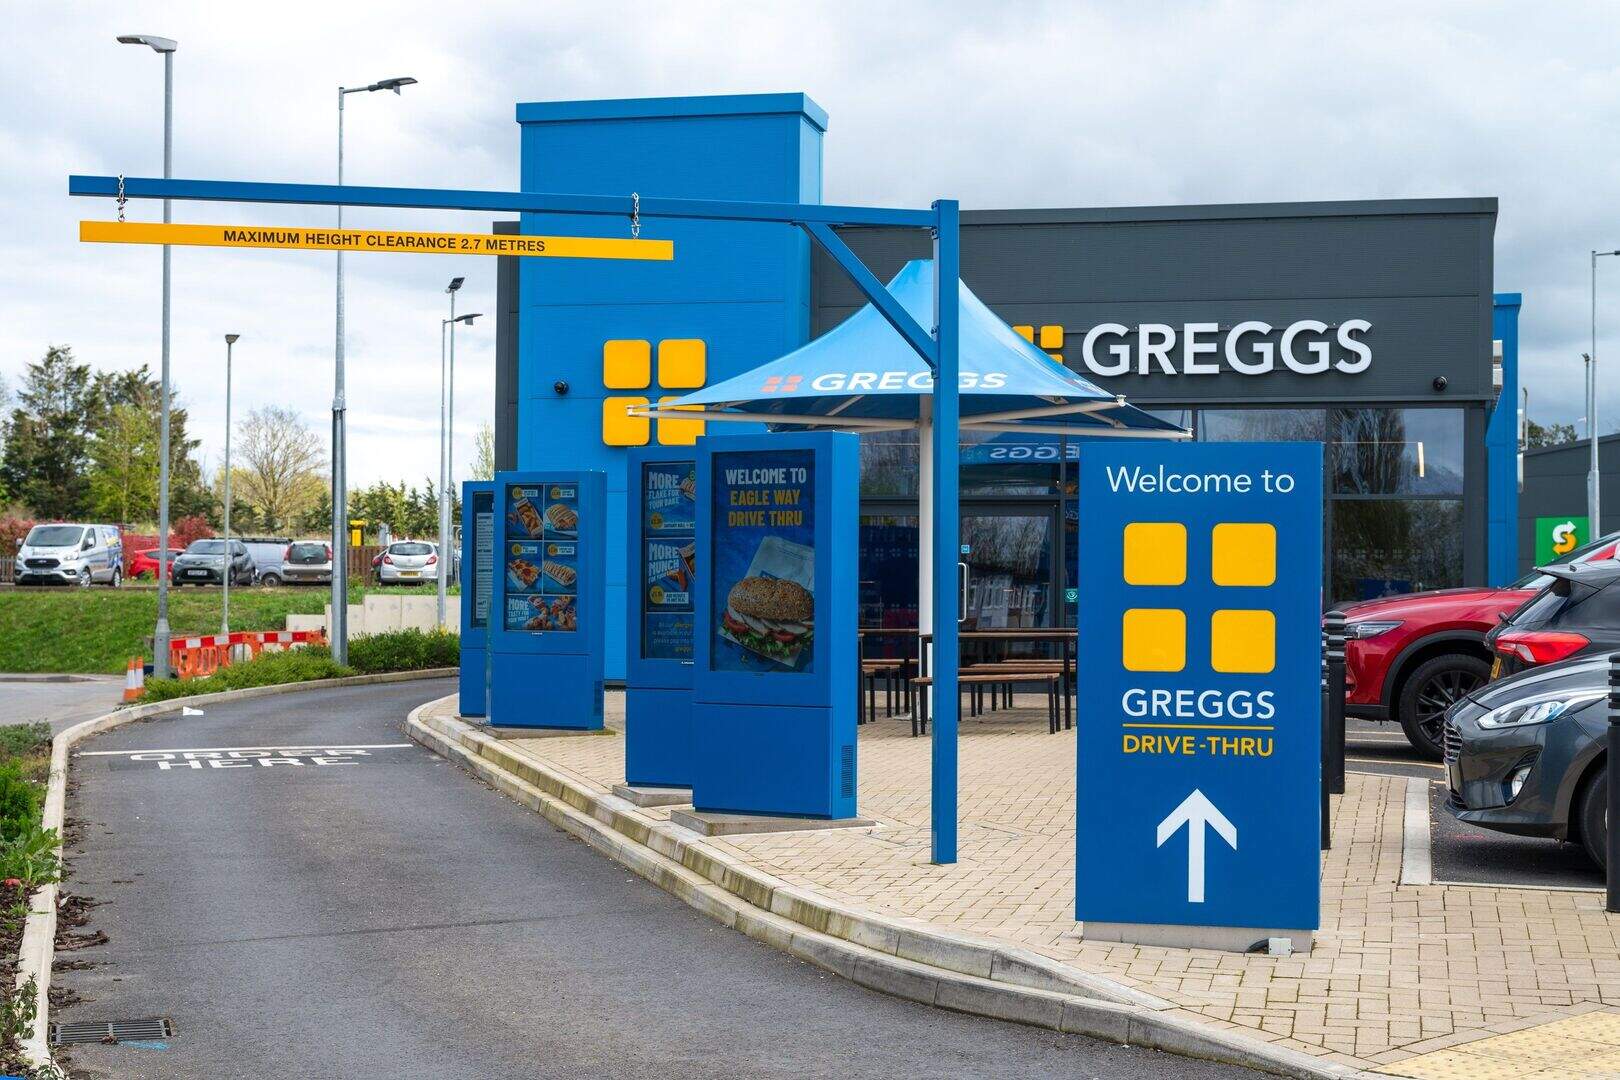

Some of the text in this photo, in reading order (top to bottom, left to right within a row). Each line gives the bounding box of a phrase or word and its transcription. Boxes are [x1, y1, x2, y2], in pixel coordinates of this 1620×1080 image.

[223, 230, 546, 252] MAXIMUM HEIGHT CLEARANCE 2.7 METRES
[1082, 319, 1372, 376] GREGGS
[811, 371, 1008, 391] GREGGS
[648, 471, 680, 490] MORE
[725, 467, 807, 485] WELCOME TO
[1106, 464, 1295, 493] Welcome to
[730, 489, 801, 506] EAGLE WAY
[728, 510, 803, 527] DRIVE THRU
[648, 542, 680, 561] MORE
[648, 557, 680, 577] MUNCH
[508, 597, 529, 611] MORE
[1121, 688, 1276, 719] GREGGS
[130, 749, 372, 761] ORDER
[1122, 734, 1274, 757] DRIVE-THRU
[158, 756, 360, 770] HERE
